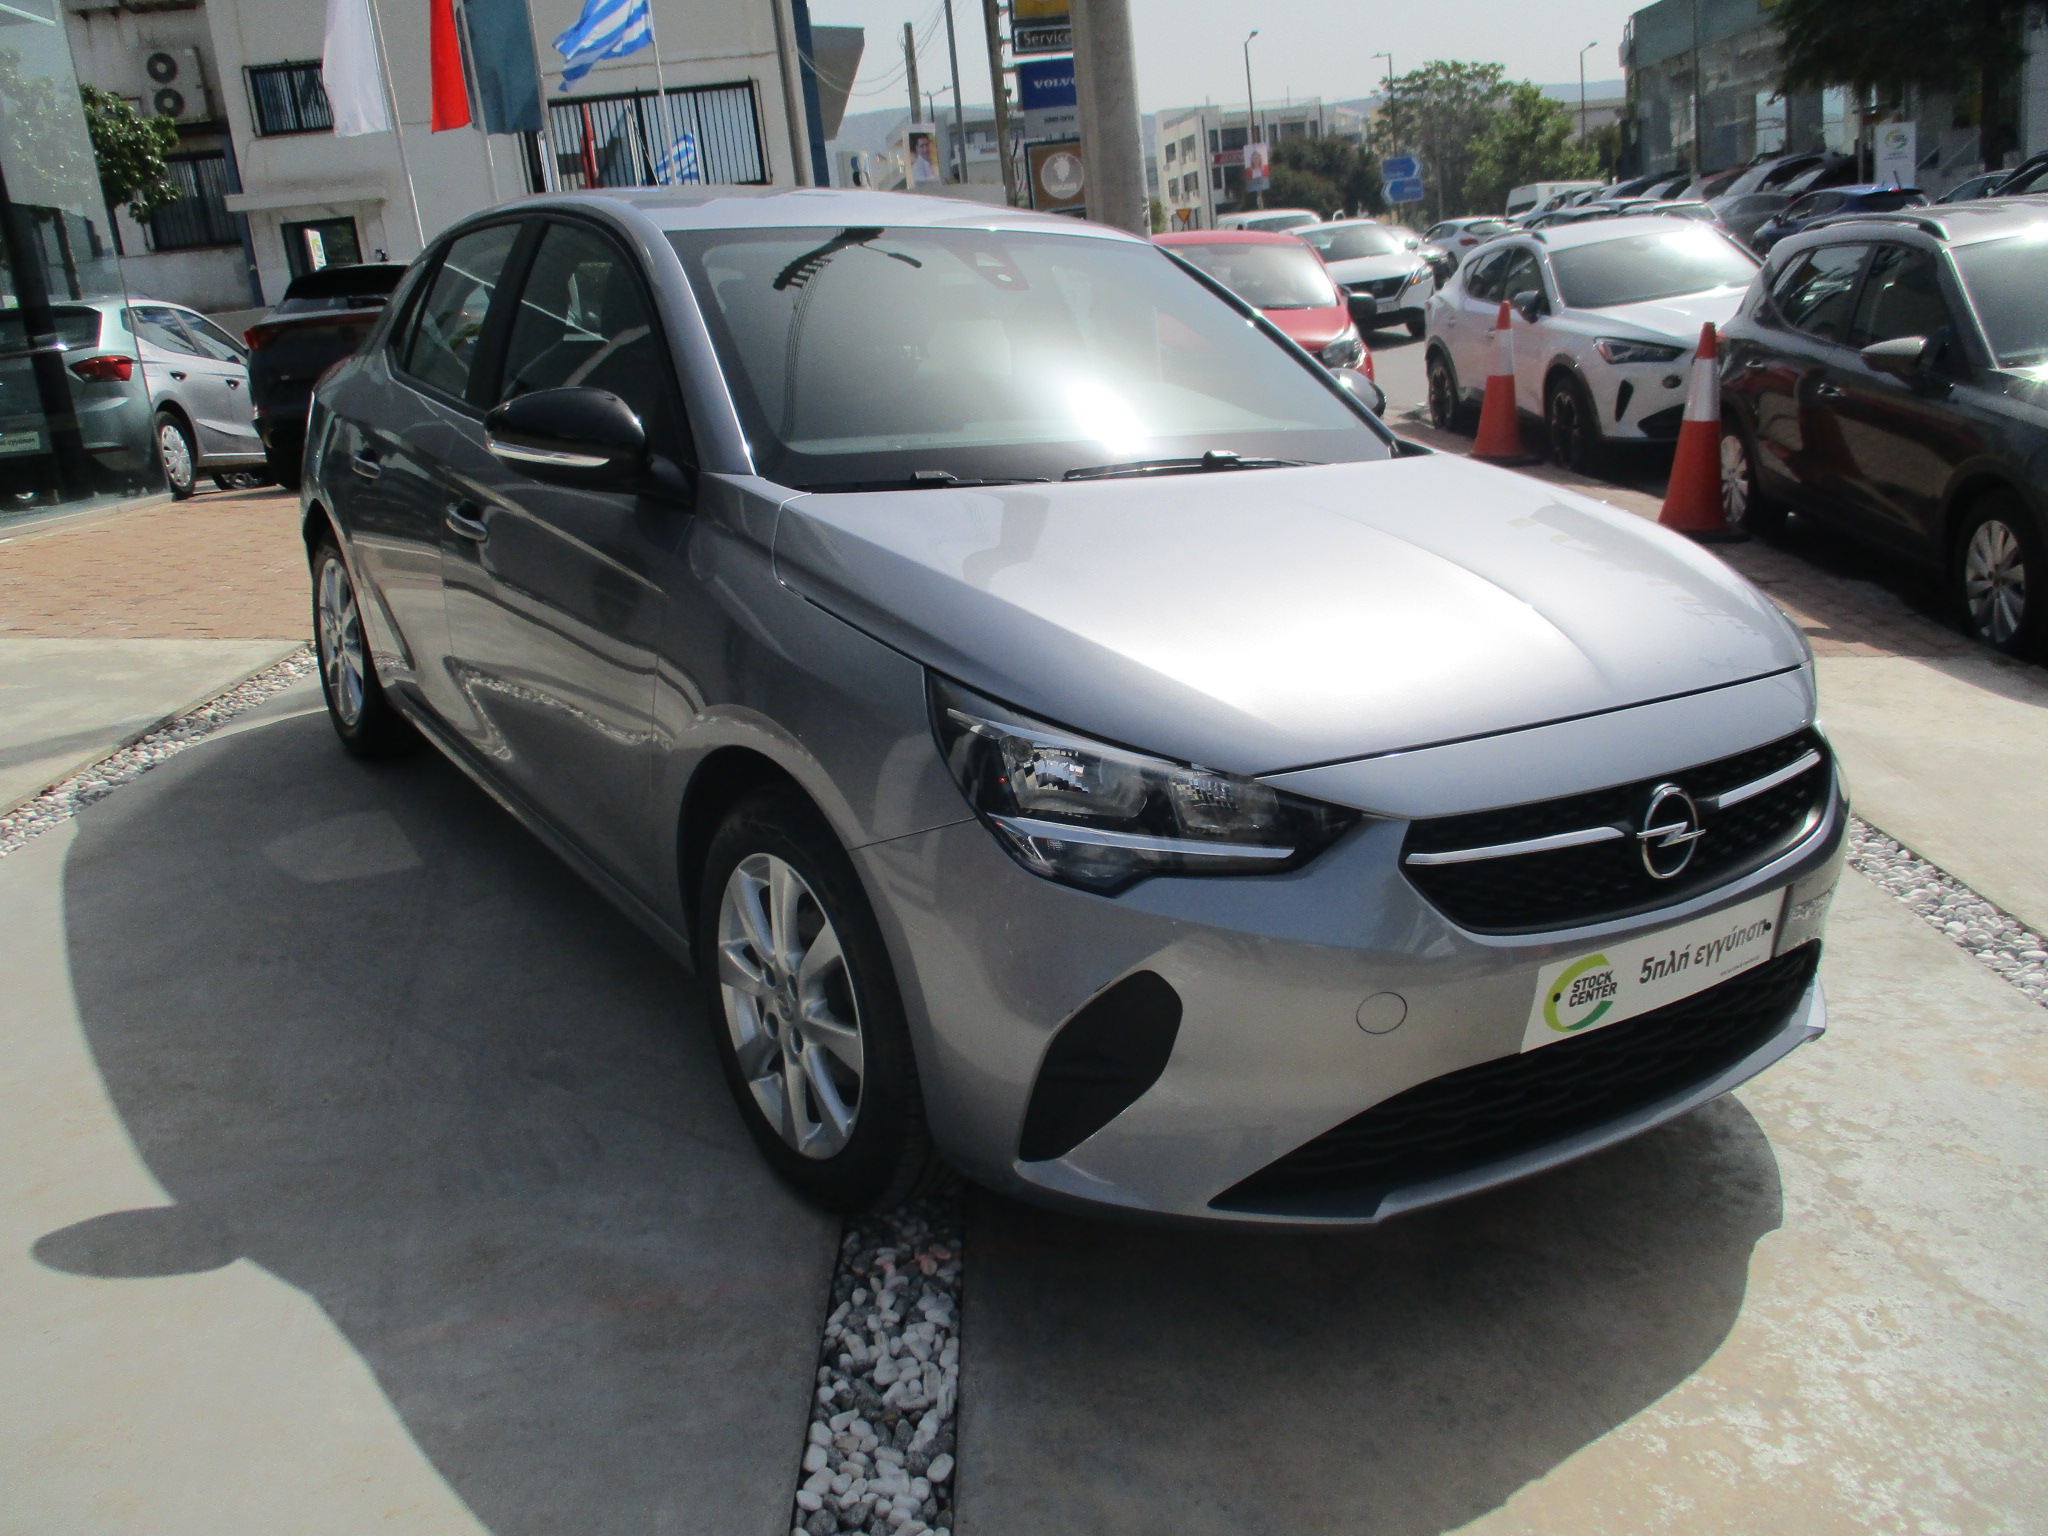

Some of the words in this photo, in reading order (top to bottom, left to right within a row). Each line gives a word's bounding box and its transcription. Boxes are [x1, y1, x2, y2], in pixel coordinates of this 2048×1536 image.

[1639, 944, 1691, 984] 5πλή
[1572, 969, 1615, 993] STOCK
[1569, 982, 1618, 1007] CENTER
